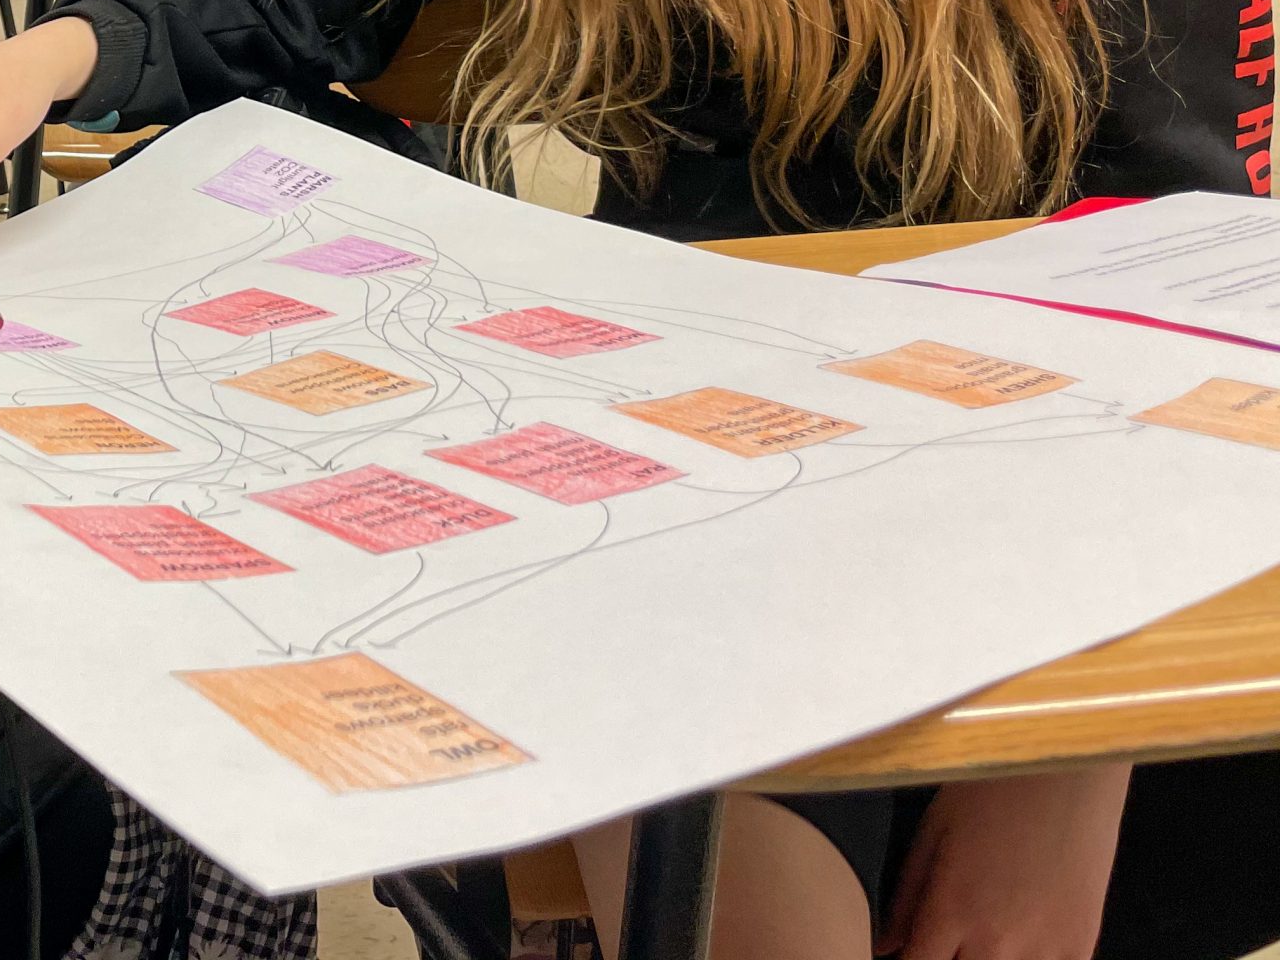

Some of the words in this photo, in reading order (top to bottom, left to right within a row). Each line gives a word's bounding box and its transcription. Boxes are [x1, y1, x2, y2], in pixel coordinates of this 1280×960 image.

[262, 157, 287, 176] water
[274, 161, 299, 176] CO2
[270, 165, 307, 189] sunlight
[278, 170, 321, 197] PLANTS
[290, 174, 333, 200] MARSH
[952, 356, 990, 371] mice
[964, 361, 1009, 378] snails
[364, 380, 411, 396] BASS
[994, 373, 1057, 396] SHREW
[751, 420, 840, 447] KILLDEER
[628, 463, 667, 480] RAT
[430, 508, 494, 529] DUCK
[159, 558, 272, 573] SPARROW
[350, 693, 425, 713] ducks
[331, 705, 447, 734] sparrows
[418, 719, 469, 739] rats
[428, 737, 502, 764] OWL
